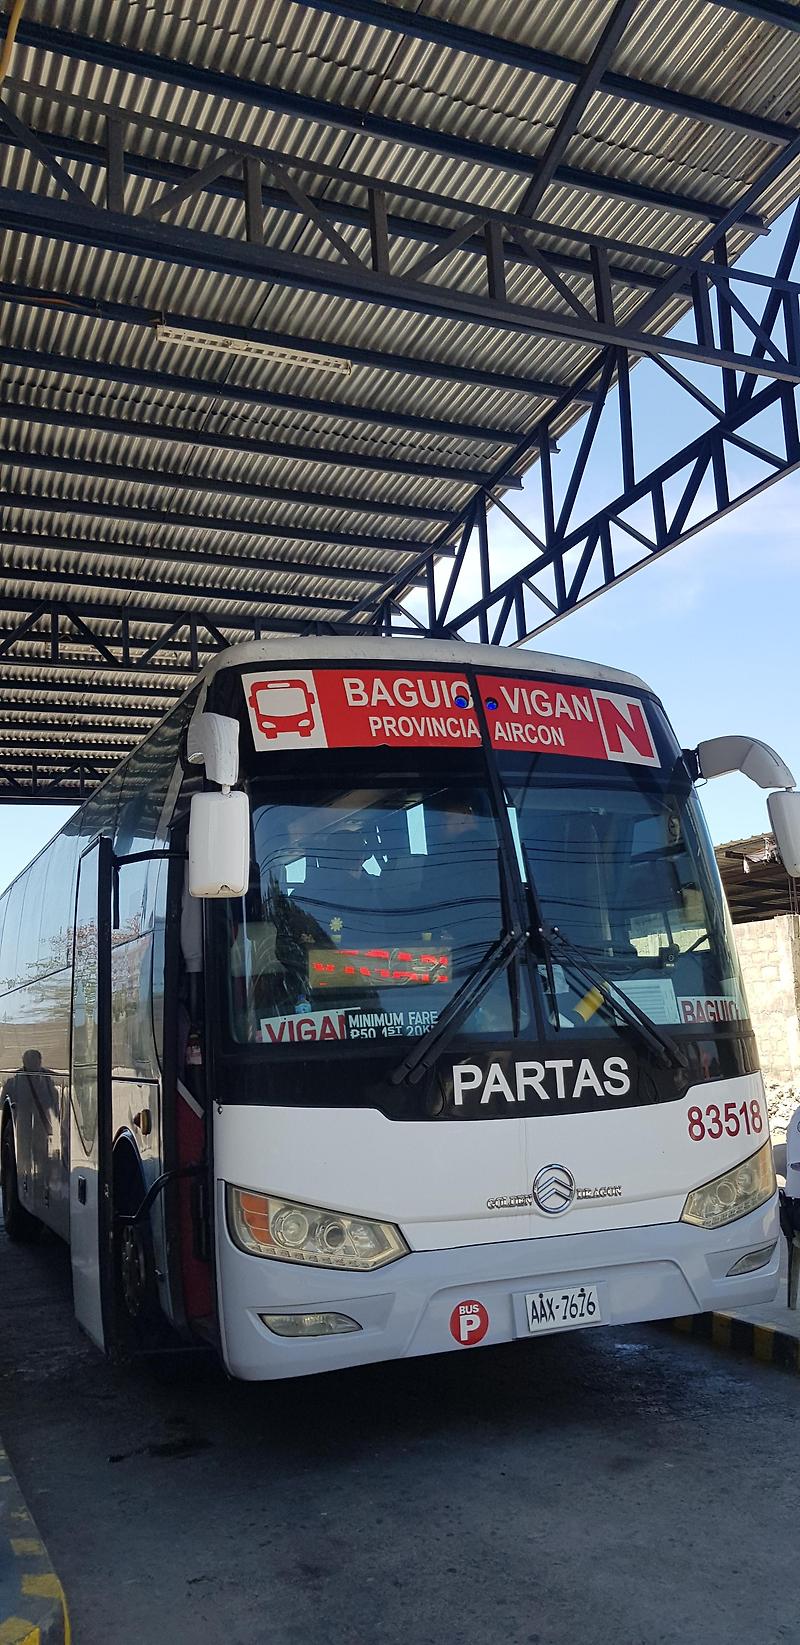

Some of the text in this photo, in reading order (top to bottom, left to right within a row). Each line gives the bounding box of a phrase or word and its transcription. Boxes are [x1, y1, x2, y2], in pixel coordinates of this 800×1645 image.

[343, 677, 593, 723] BAGUIO VIGAN
[368, 716, 566, 747] PROVINCIA AIRCON
[601, 697, 655, 759] N
[348, 1011, 439, 1028] MINIMUM FARE
[406, 1024, 434, 1037] 20K
[452, 1056, 631, 1106] PARTAS
[687, 1099, 763, 1142] 83518
[486, 1185, 623, 1210] GOLDEN DRAGON
[459, 1304, 480, 1315] BUS
[531, 1291, 596, 1324] AAX-7676
[459, 1315, 481, 1341] P
